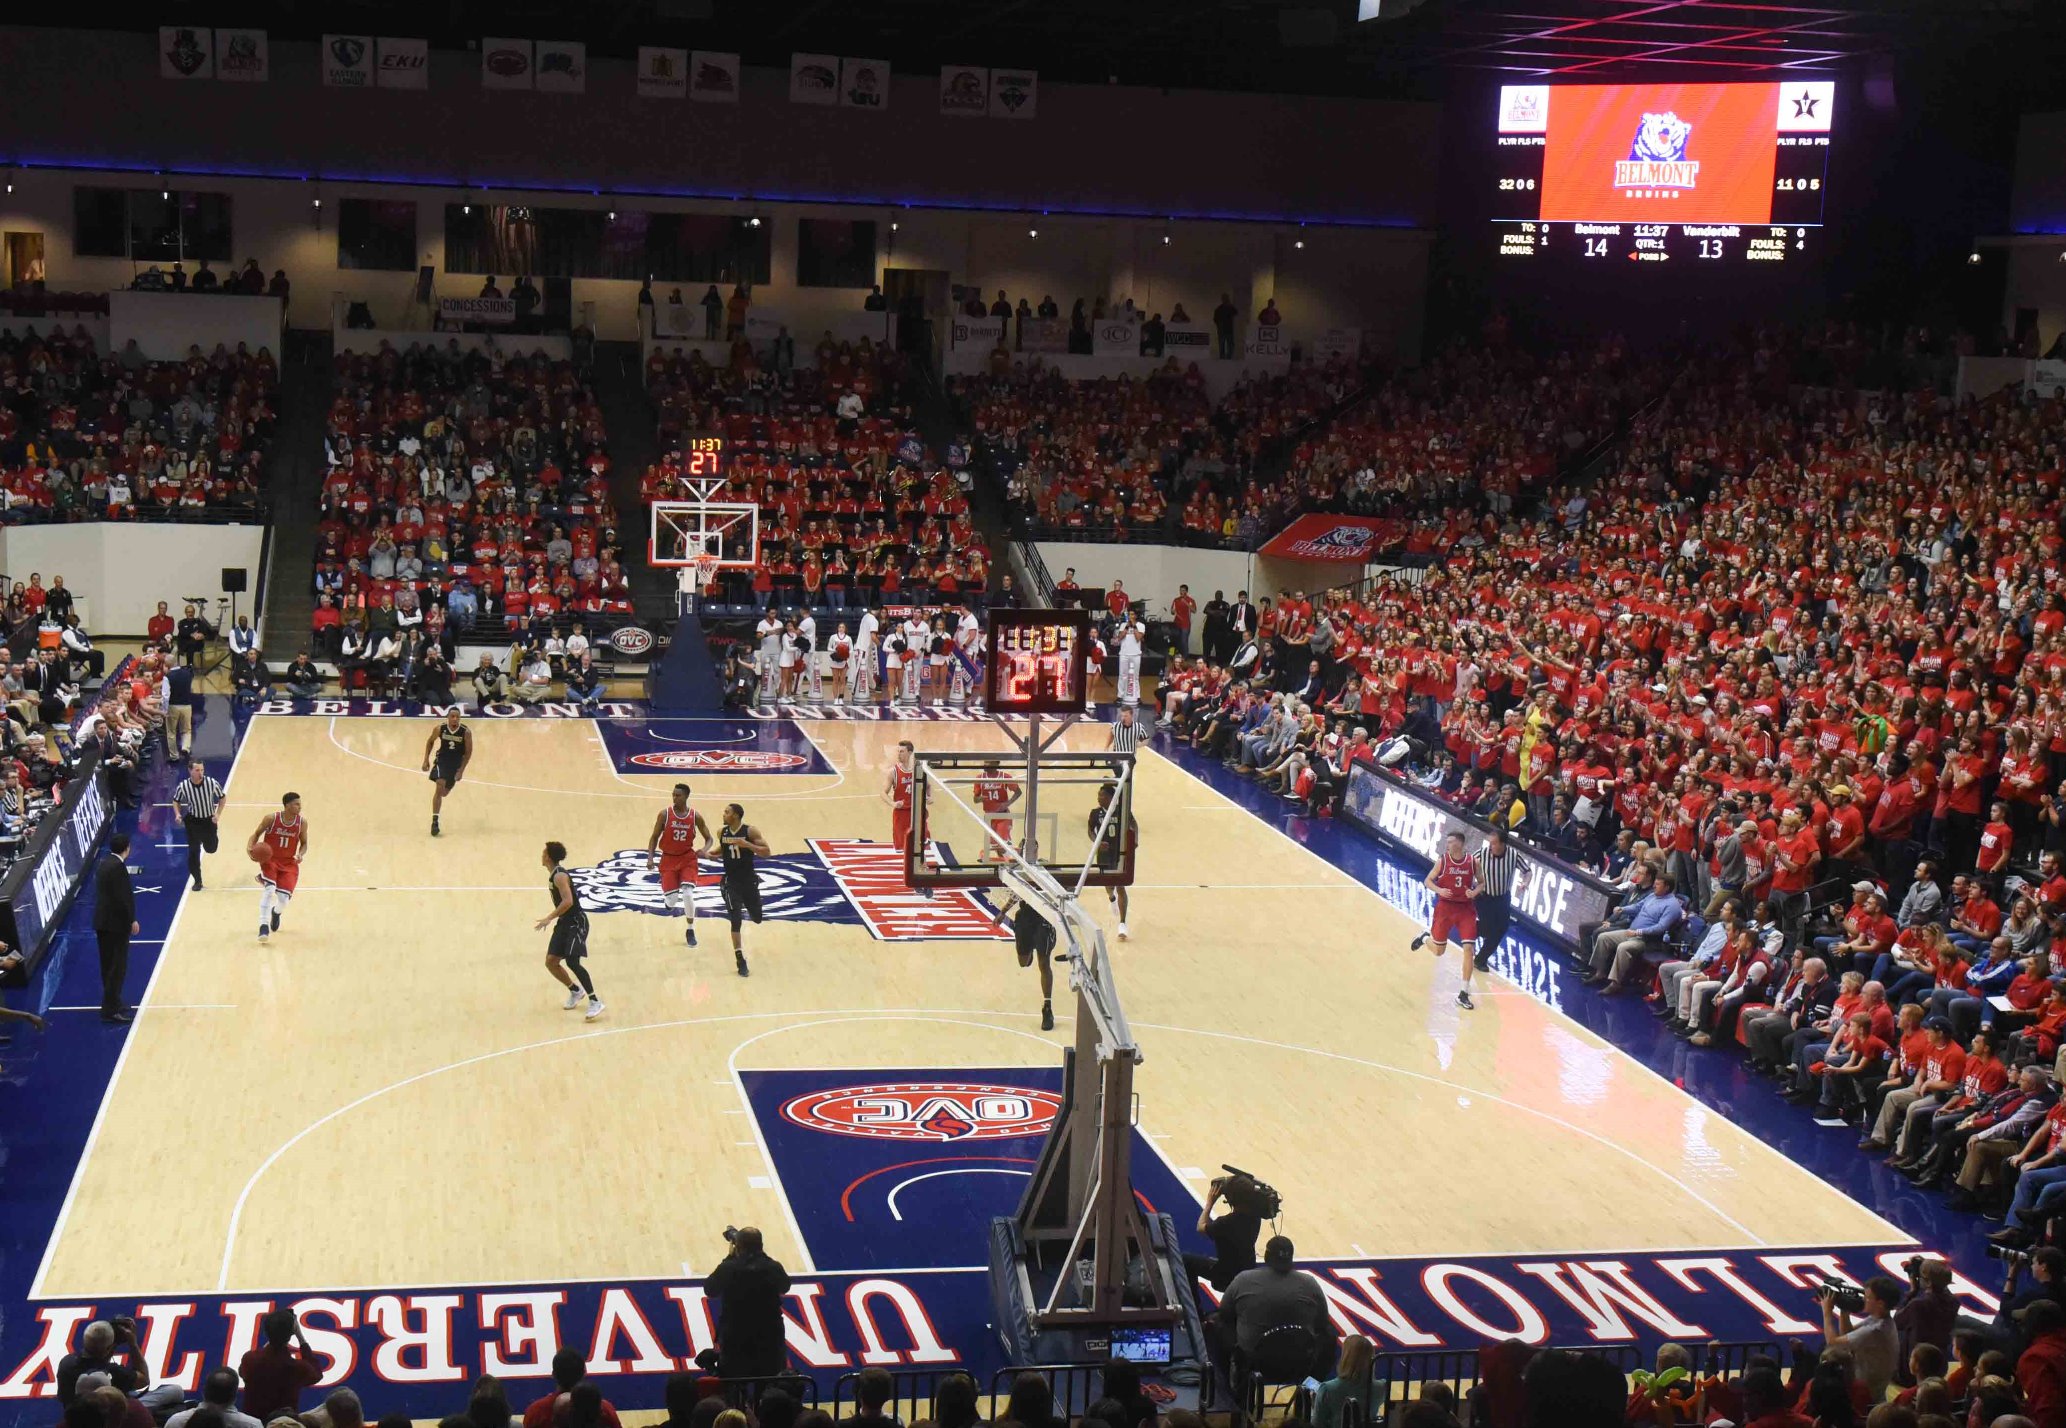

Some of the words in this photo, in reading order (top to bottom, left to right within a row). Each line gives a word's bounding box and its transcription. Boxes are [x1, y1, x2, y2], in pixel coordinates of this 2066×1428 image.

[383, 54, 426, 67] EKU
[1498, 137, 1517, 146] PLYR
[1517, 137, 1532, 146] FLS
[1777, 137, 1796, 146] PLYR
[1814, 137, 1830, 146] PTS
[1617, 162, 1698, 186] BELMONT
[1499, 179, 1514, 190] 32
[1516, 179, 1525, 190] 0
[1526, 179, 1535, 190] 6
[1777, 179, 1794, 190] 11
[1796, 179, 1806, 190] 0
[1810, 179, 1820, 190] 5
[1626, 190, 1679, 199] BRUINS
[1522, 223, 1536, 232] TO:
[1542, 224, 1549, 233] 0
[1575, 224, 1620, 235] Belmont
[1634, 225, 1669, 237] 11:37
[1683, 225, 1740, 237] Vanderbilt
[1770, 228, 1787, 237] TO:
[1796, 228, 1806, 238] 0
[1503, 235, 1534, 244] FOULS:
[1541, 236, 1548, 245] 1
[1750, 240, 1785, 249] FOULS:
[1796, 240, 1804, 250] 4
[1500, 245, 1534, 255] BONUS:
[1584, 238, 1608, 257] 14
[1699, 240, 1723, 259] 13
[1747, 250, 1784, 260] BONUS:
[442, 299, 515, 314] CONCESSIONS
[692, 438, 721, 451] 11:37
[690, 451, 717, 474] 27
[620, 635, 643, 646] OVC
[1014, 626, 1072, 652] 11:37
[1009, 655, 1064, 700] 27
[258, 700, 634, 718] BELMONT
[448, 741, 455, 750] 2
[988, 790, 999, 801] 14
[673, 829, 687, 842] 32
[279, 837, 289, 848] 11
[728, 844, 741, 859] 11
[1455, 876, 1462, 887] 3
[852, 1096, 1034, 1125] OVC
